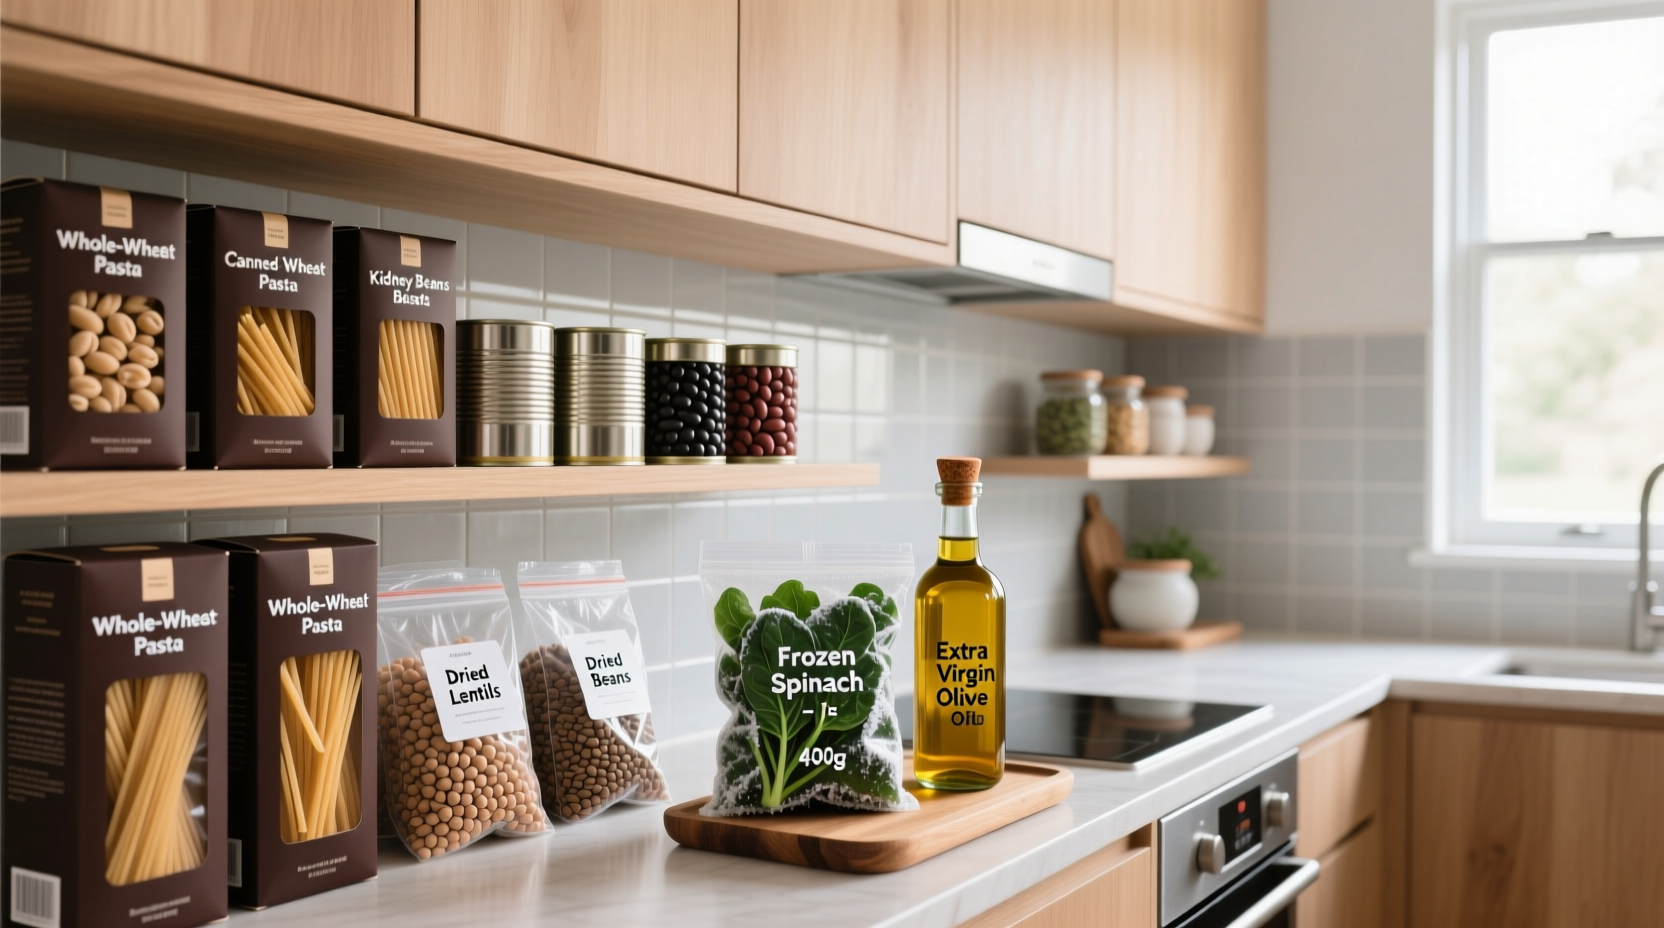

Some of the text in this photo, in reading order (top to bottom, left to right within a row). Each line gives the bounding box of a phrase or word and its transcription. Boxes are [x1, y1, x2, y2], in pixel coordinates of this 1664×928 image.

[56, 229, 176, 260] Whole-Wheat
[94, 254, 142, 278] Pasta
[224, 250, 327, 276] Canned Wheat
[259, 274, 299, 293] Pasta
[369, 270, 414, 292] Kidney
[267, 592, 370, 618] Whole-Wheat
[92, 608, 219, 637] Whole-Wheat
[301, 615, 343, 635] Pasta
[134, 634, 184, 657] Pasta
[778, 646, 856, 667] Frozen
[936, 641, 988, 661] Extra
[584, 652, 623, 671] Dried
[445, 663, 490, 686] Dried
[590, 670, 632, 688] Beans
[771, 670, 864, 700] Spinach
[936, 663, 996, 688] Virgin
[449, 682, 502, 707] Lentils
[936, 687, 988, 707] Olive
[798, 746, 847, 770] 400g
